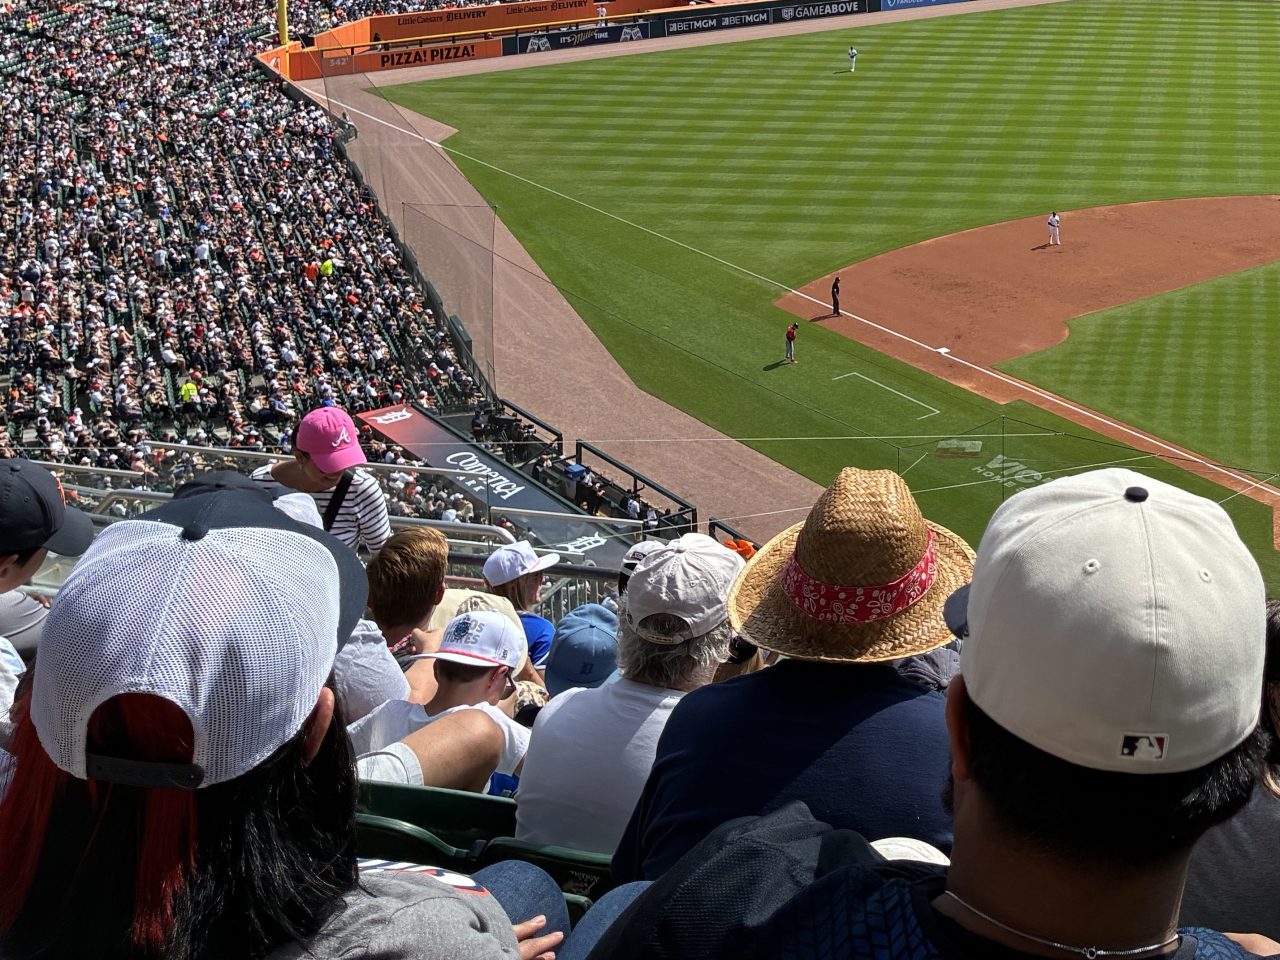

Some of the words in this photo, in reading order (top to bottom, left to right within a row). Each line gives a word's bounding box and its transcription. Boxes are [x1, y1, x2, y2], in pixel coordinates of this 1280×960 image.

[506, 5, 524, 15] Little
[524, 3, 548, 14] Caesars
[550, 0, 588, 11] DELIVERY
[795, 1, 859, 18] GAMEABOVE
[397, 14, 417, 26] Little
[417, 12, 443, 24] Caesars
[446, 10, 487, 22] DELIVERY
[676, 18, 717, 32] BETMGM
[728, 12, 767, 25] BETMGM
[381, 49, 427, 67] PIZZA!
[430, 45, 475, 63] PIZZA!
[972, 466, 1017, 488] HOME
